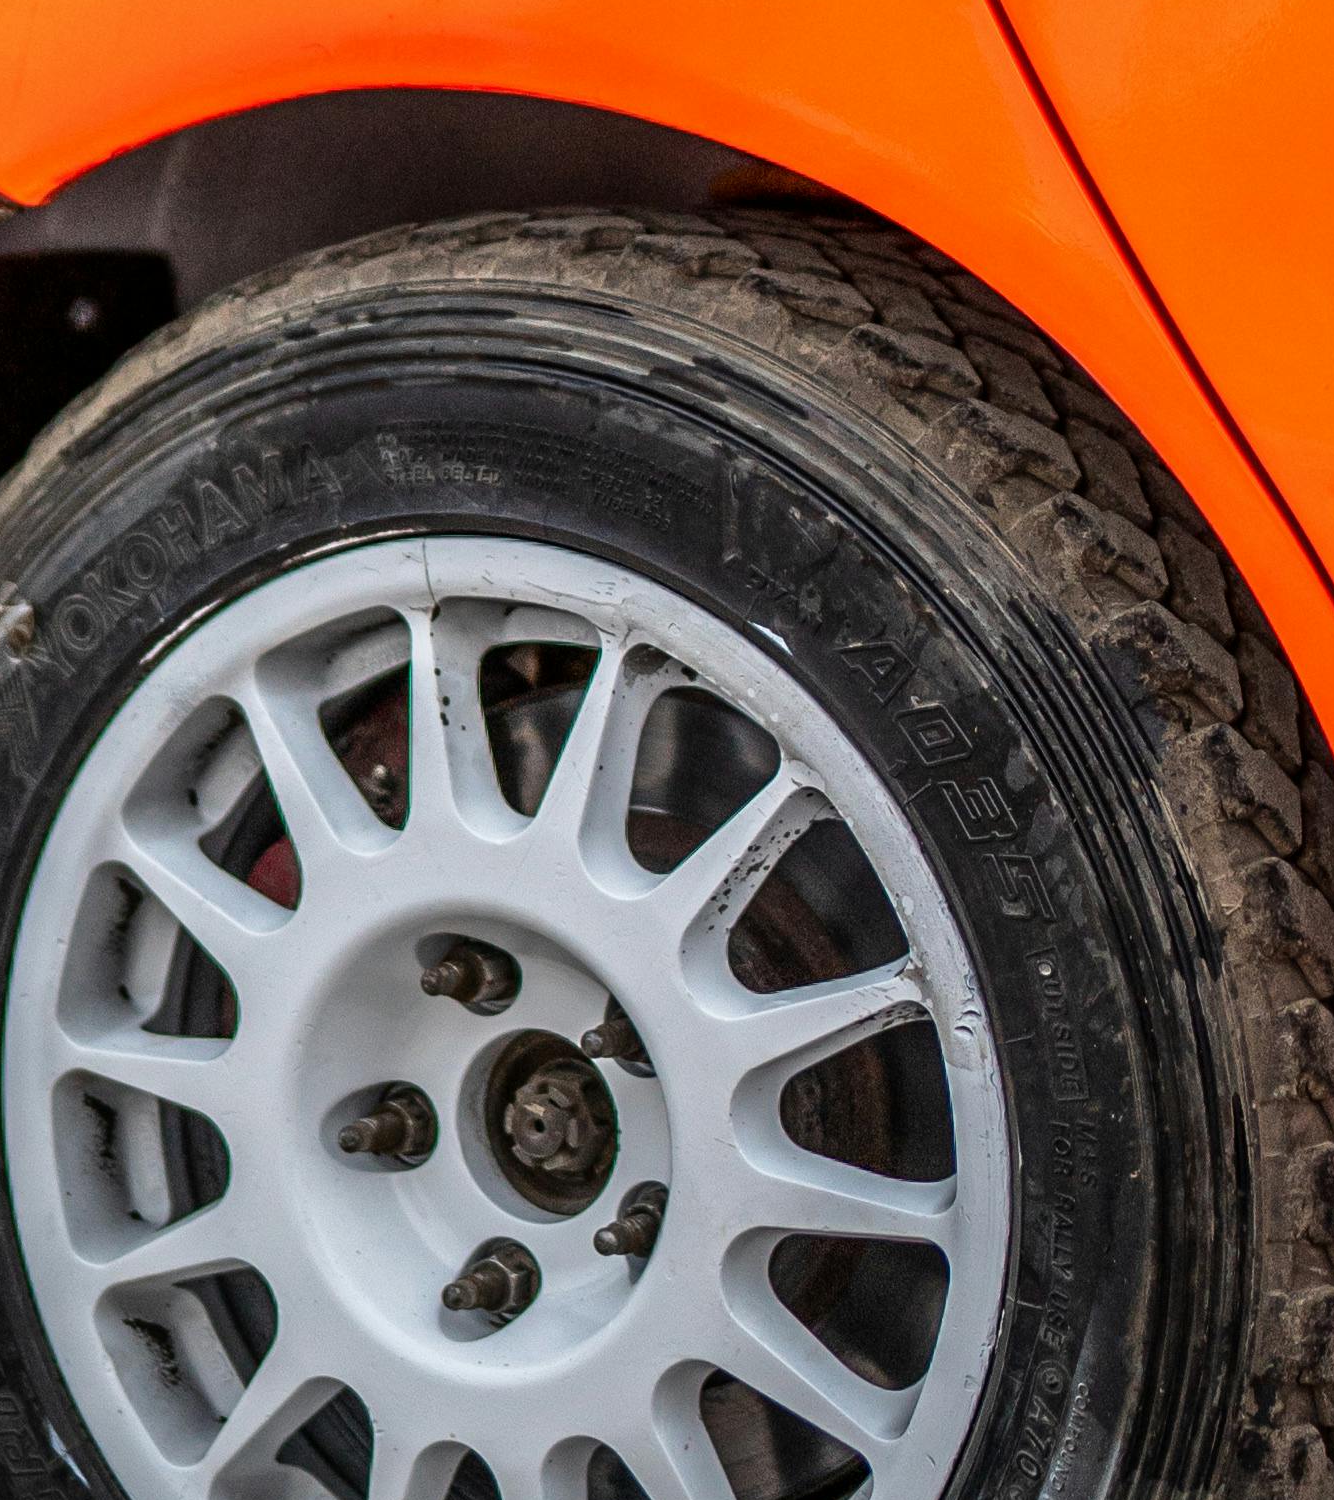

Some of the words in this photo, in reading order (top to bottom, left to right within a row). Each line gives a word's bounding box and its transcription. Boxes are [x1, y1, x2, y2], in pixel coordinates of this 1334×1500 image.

[22, 430, 344, 682] YOKOHAMA
[1040, 1285, 1073, 1350] USE
[1013, 1395, 1062, 1482] A70
[1049, 1380, 1089, 1488] COMPOUND
